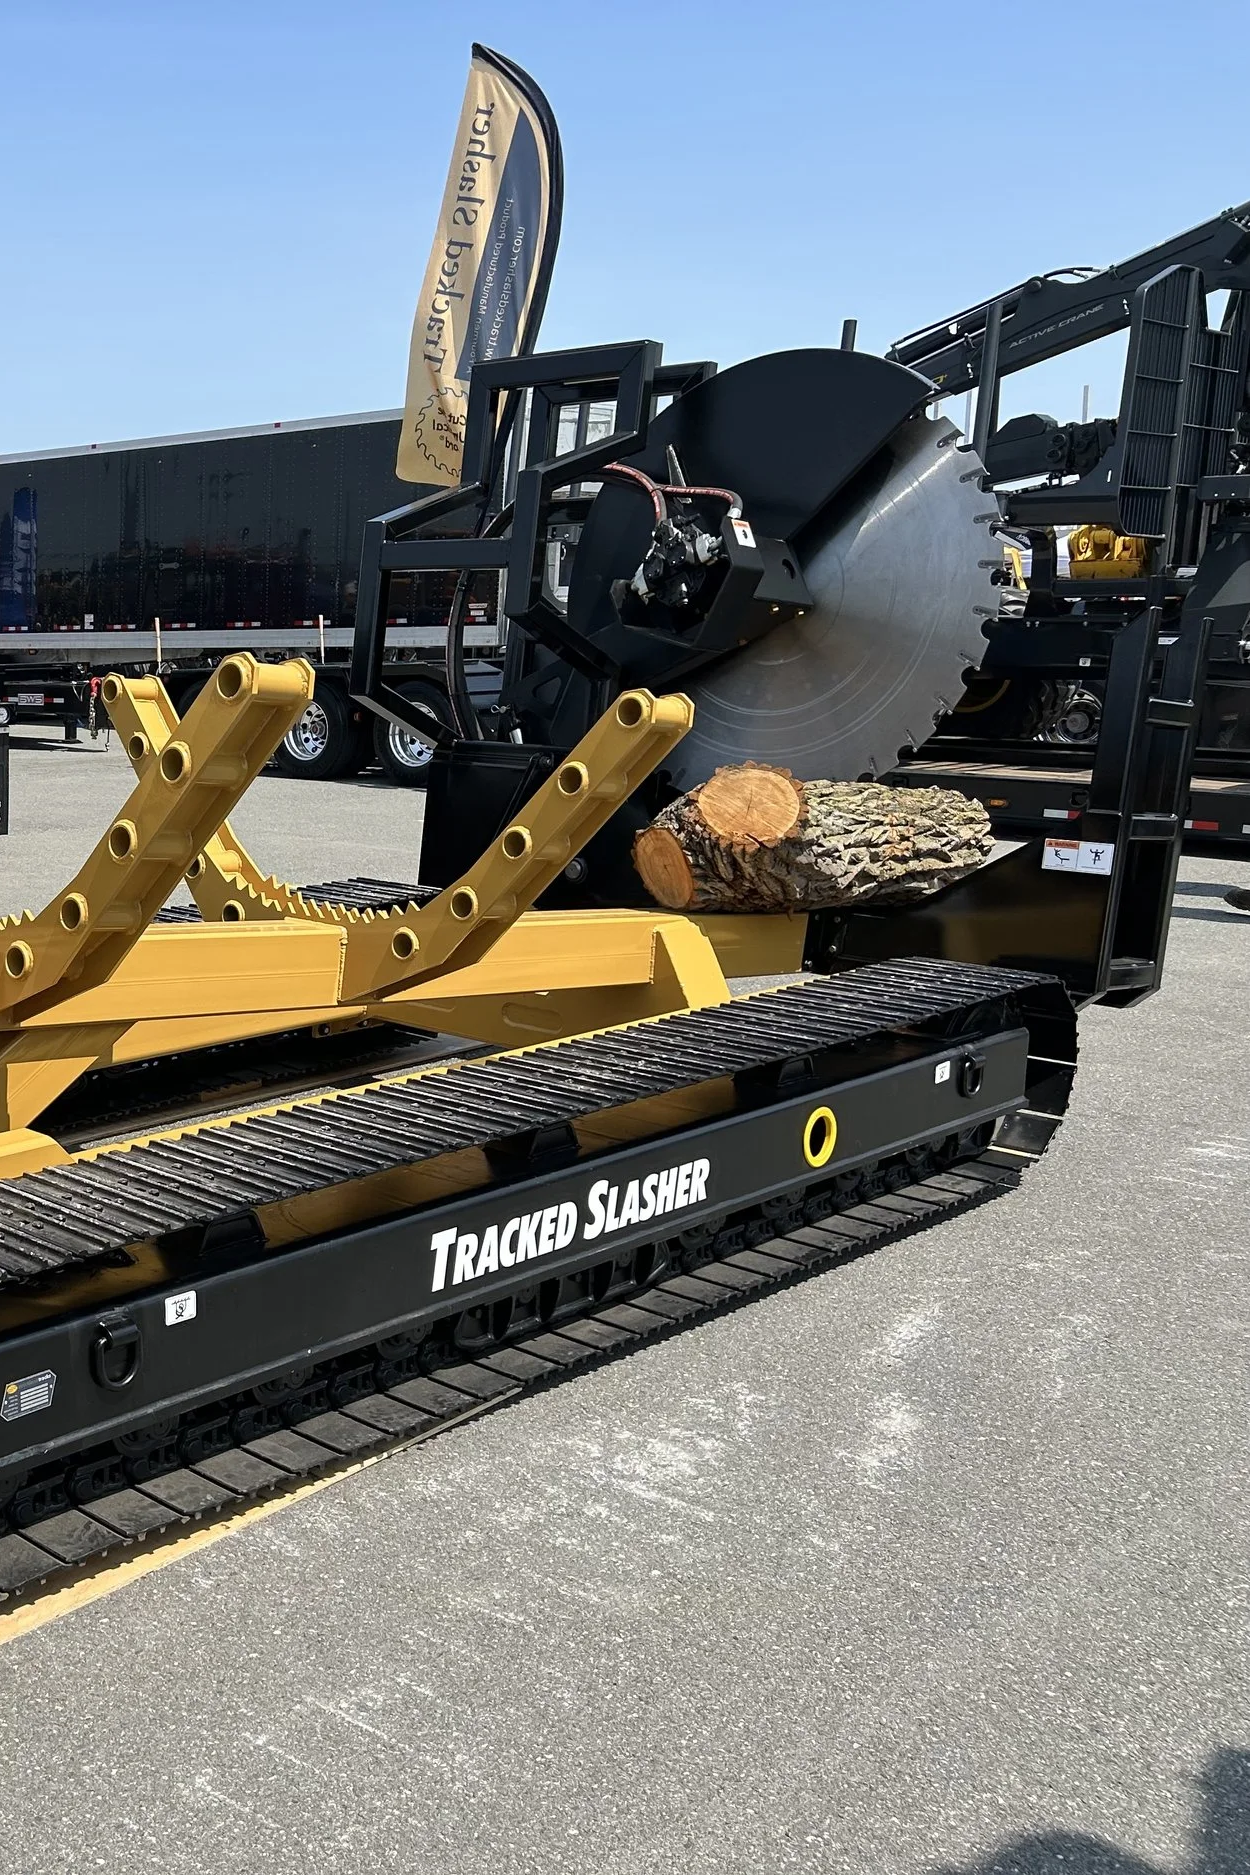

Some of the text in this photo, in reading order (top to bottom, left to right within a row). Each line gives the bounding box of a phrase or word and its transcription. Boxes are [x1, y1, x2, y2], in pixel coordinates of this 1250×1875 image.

[1009, 303, 1105, 349] ACTIVE CRANE
[430, 1158, 710, 1293] TRACKED SLASHER
